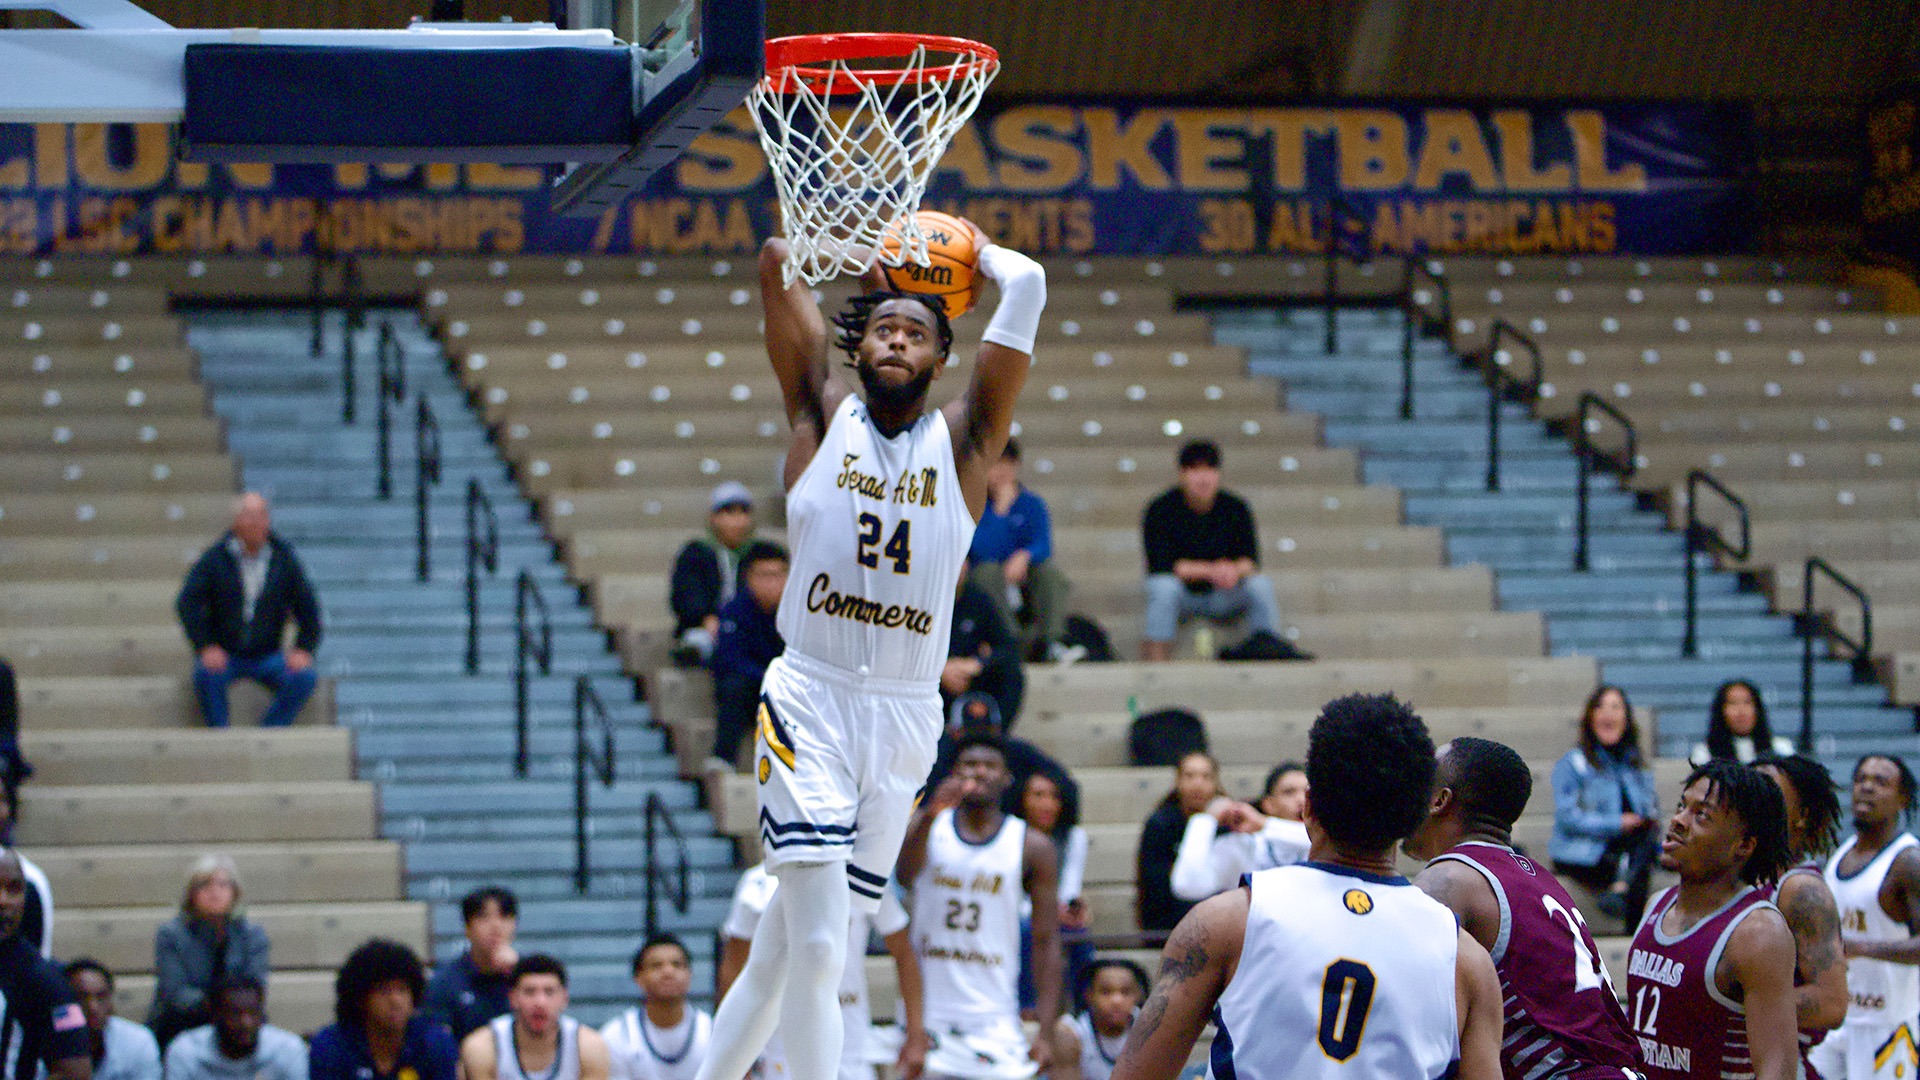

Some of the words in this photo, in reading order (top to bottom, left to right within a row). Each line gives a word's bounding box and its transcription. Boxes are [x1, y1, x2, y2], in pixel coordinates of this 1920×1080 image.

[632, 199, 756, 250] NCAA
[837, 453, 887, 500] Texas
[856, 511, 911, 575] 24
[945, 899, 981, 933] 23
[1628, 948, 1685, 987] DALLAS
[1316, 956, 1378, 1065] 0
[1633, 984, 1661, 1036] 12
